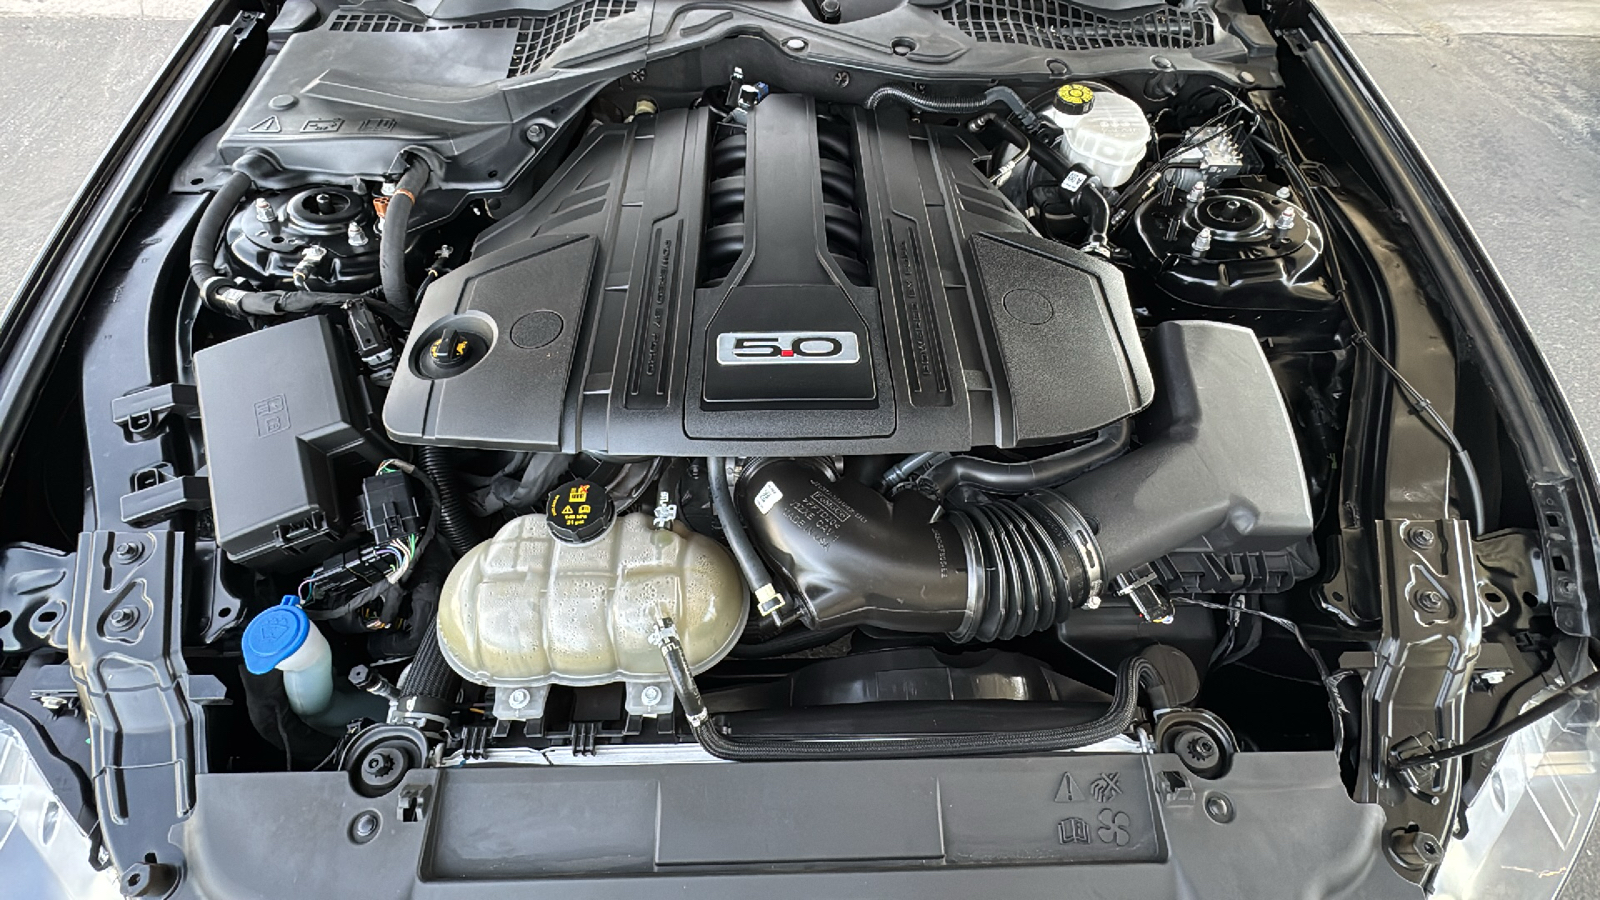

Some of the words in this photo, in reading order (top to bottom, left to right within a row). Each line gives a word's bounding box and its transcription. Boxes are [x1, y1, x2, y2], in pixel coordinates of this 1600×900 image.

[656, 239, 672, 305] POWERED
[653, 307, 664, 328] BY
[647, 333, 660, 376] FORD
[732, 337, 843, 358] 5.0
[911, 303, 932, 376] POWERED
